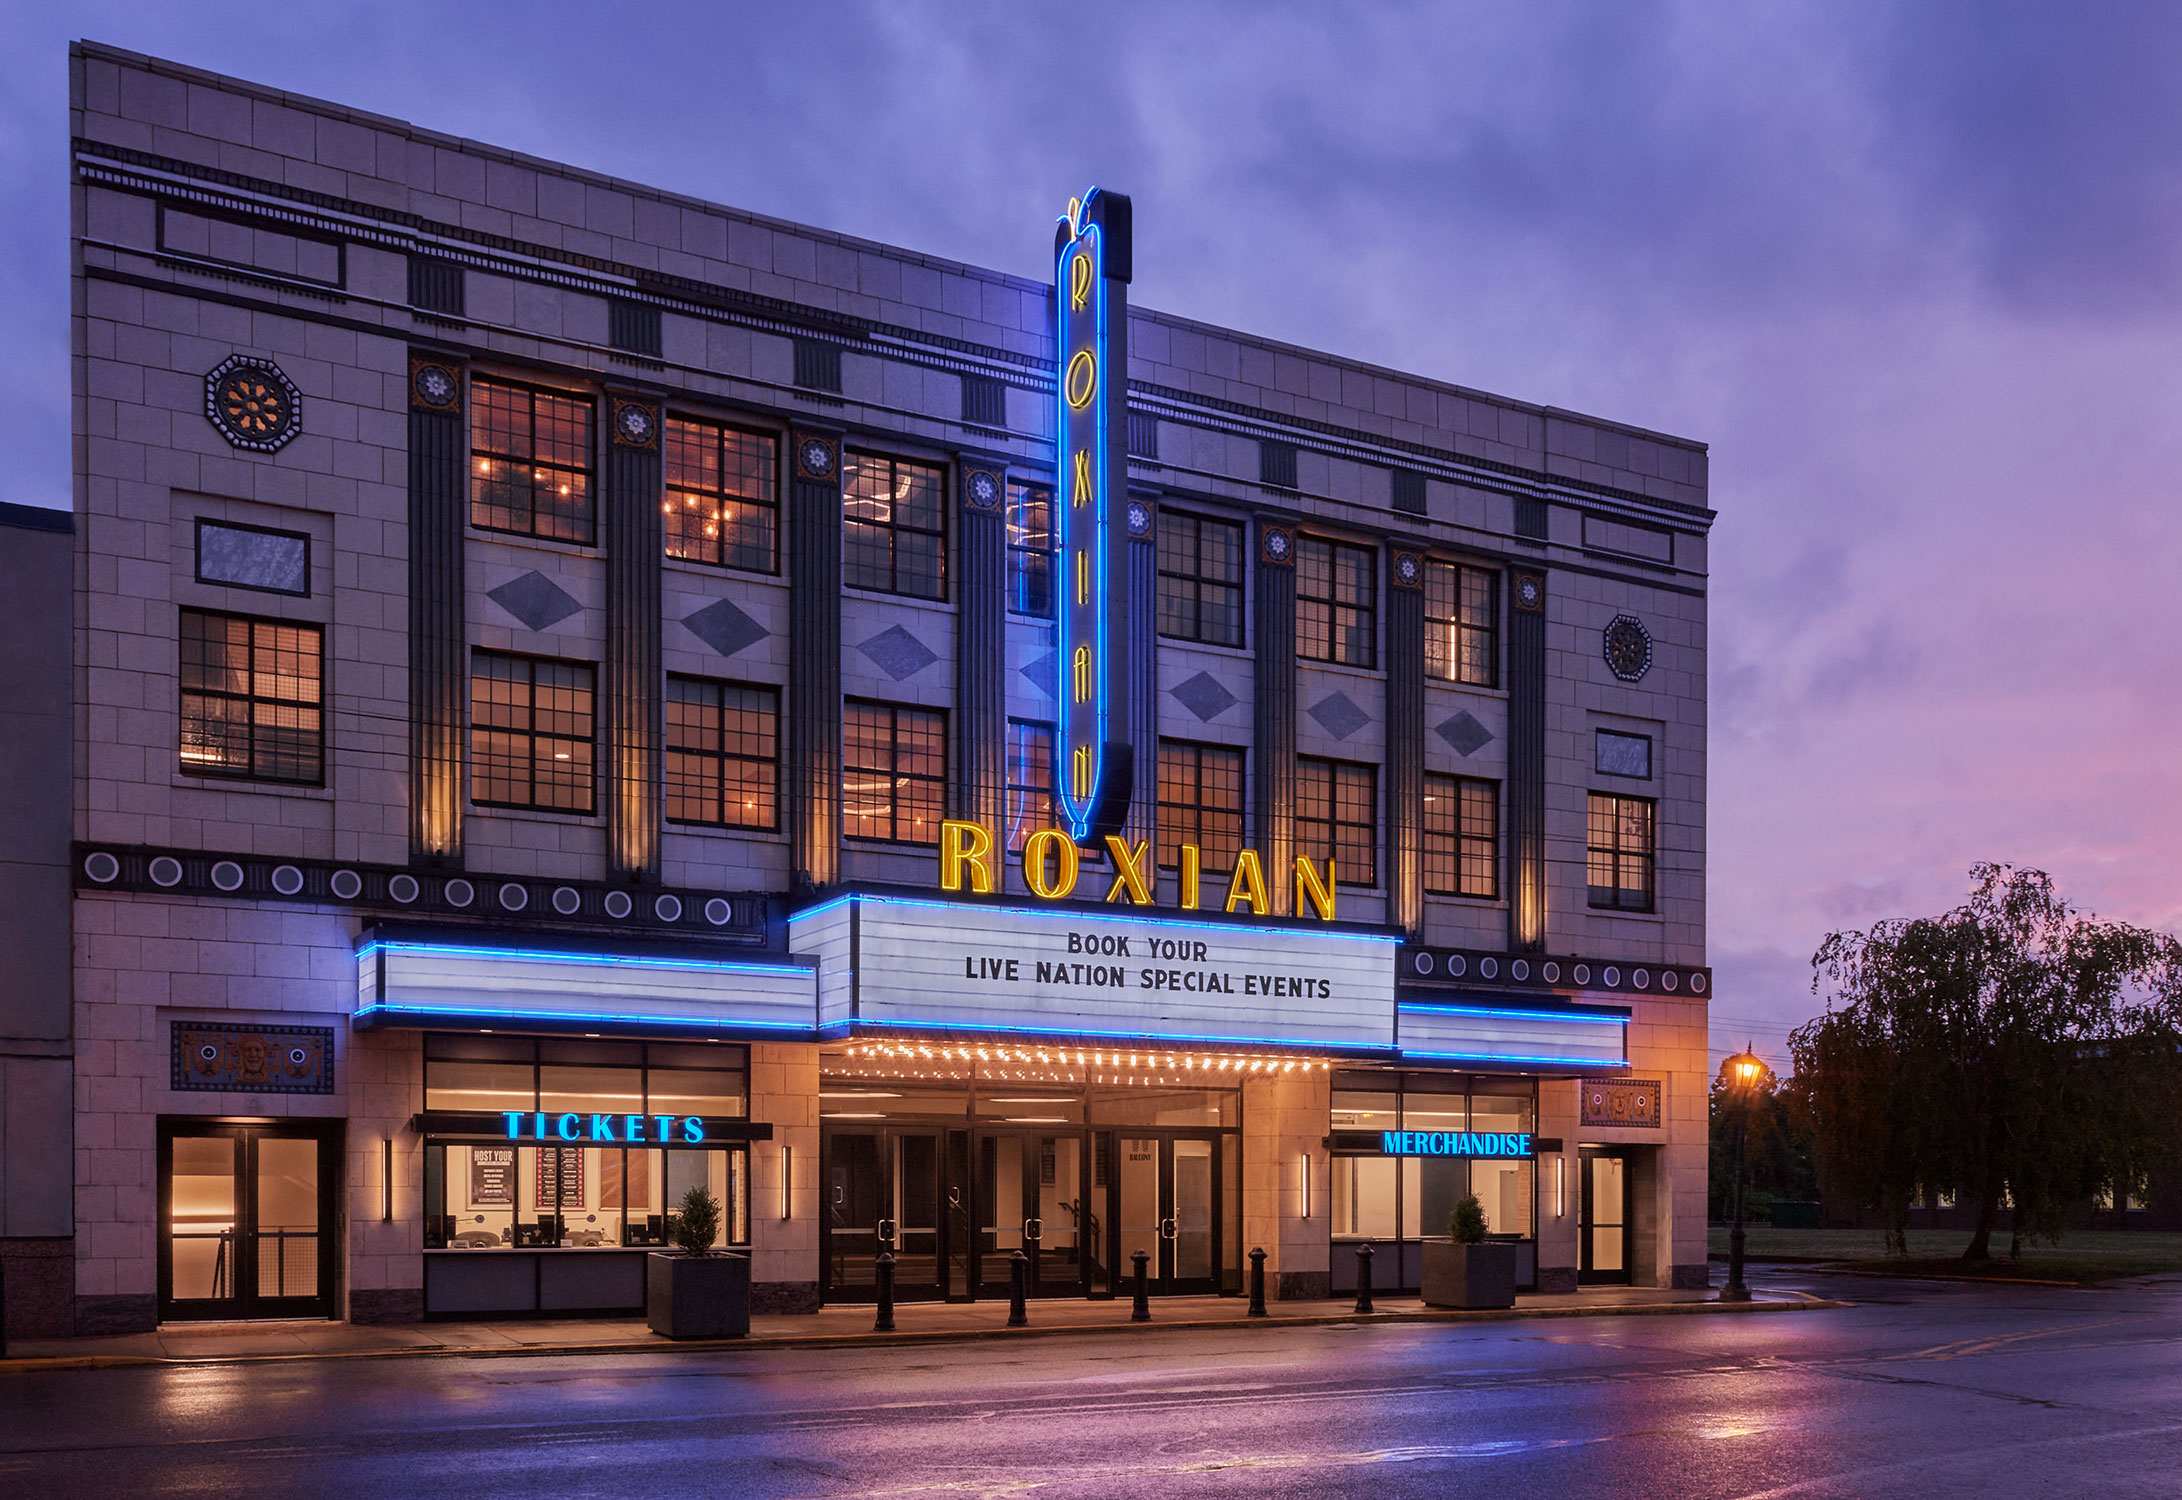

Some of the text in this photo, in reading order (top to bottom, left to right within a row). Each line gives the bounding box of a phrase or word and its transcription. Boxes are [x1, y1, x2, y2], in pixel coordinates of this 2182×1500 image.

[1064, 254, 1099, 803] ROXIAN
[940, 819, 1337, 922] ROXIAN
[1067, 932, 1208, 962] BOOK YOUR
[965, 956, 1331, 999] LIVE NATION SPECIAL EVENTS
[502, 1111, 705, 1143] TICKETS
[1383, 1131, 1531, 1155] MERCHANDISE
[474, 1150, 513, 1161] HOST YOUR
